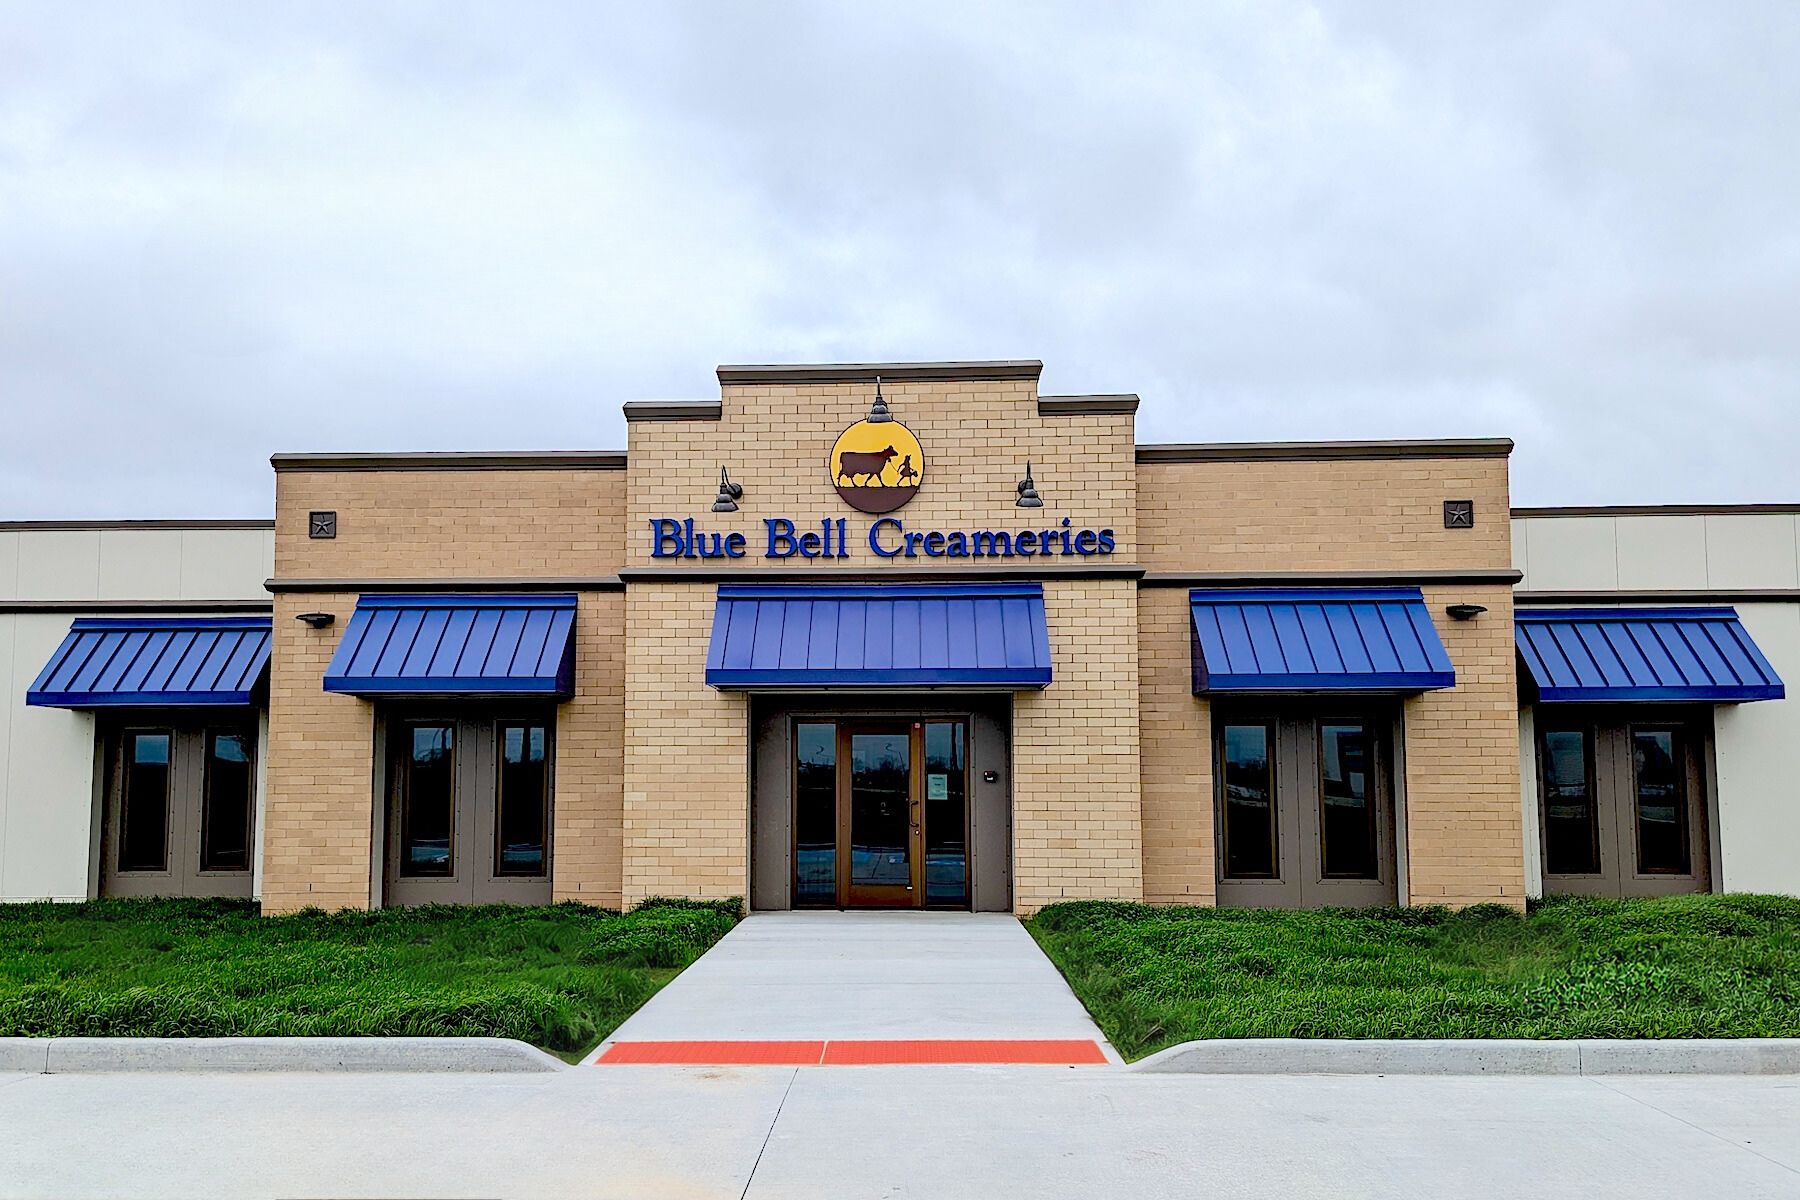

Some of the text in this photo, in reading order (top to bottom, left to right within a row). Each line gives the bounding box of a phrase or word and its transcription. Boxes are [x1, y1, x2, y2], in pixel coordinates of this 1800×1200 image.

[649, 517, 1116, 559] Blue Bell Creameries
